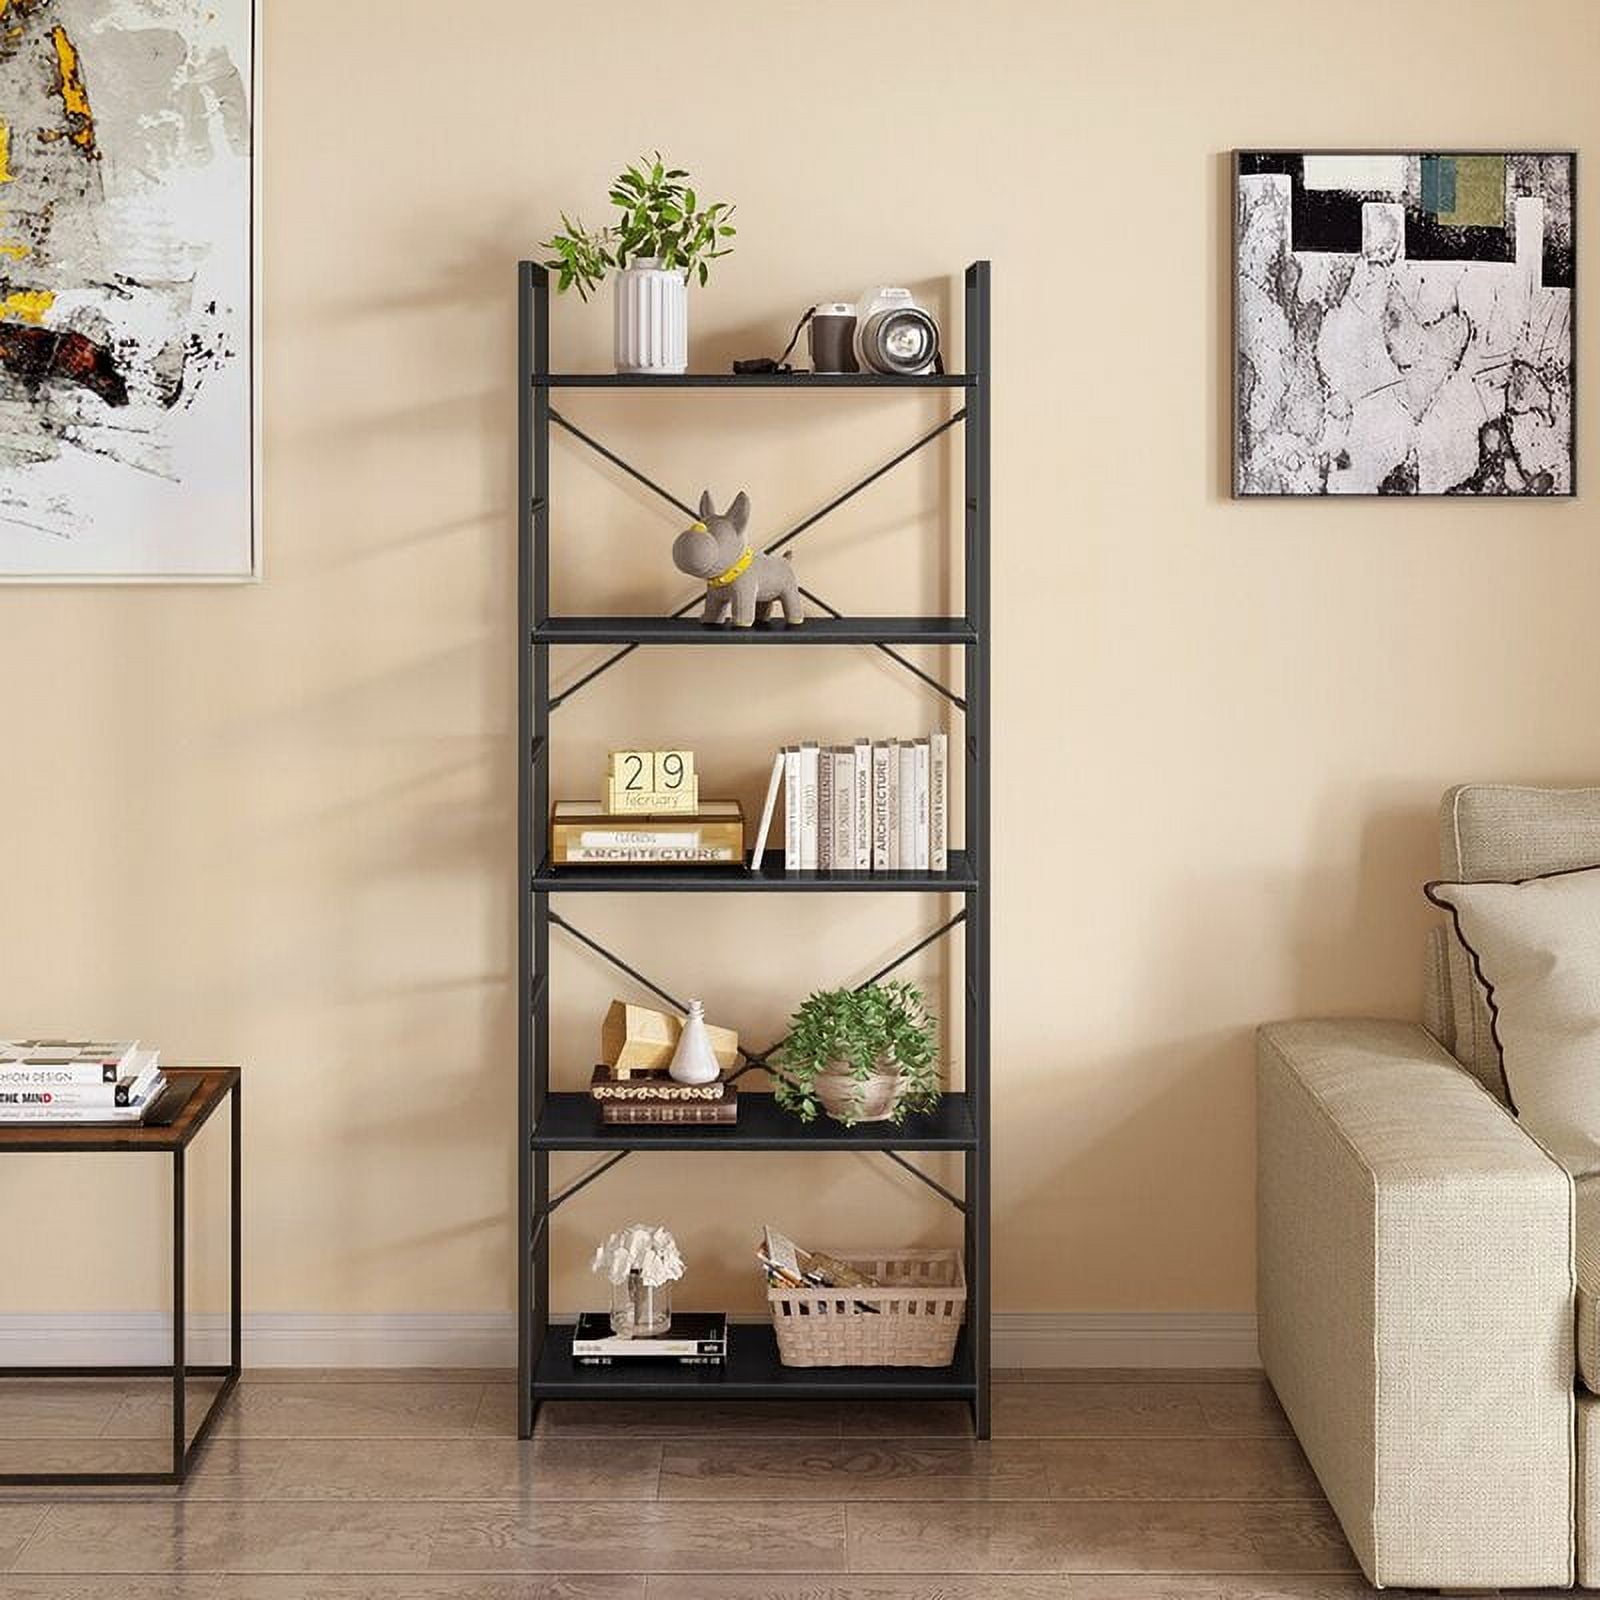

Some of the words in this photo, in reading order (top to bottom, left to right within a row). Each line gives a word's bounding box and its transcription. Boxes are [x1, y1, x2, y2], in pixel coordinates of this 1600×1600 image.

[877, 759, 889, 851] ARCHITECTURE
[582, 847, 721, 860] ARCHITECTURE
[32, 1071, 73, 1083] DESIGN
[21, 1092, 53, 1104] MIND
